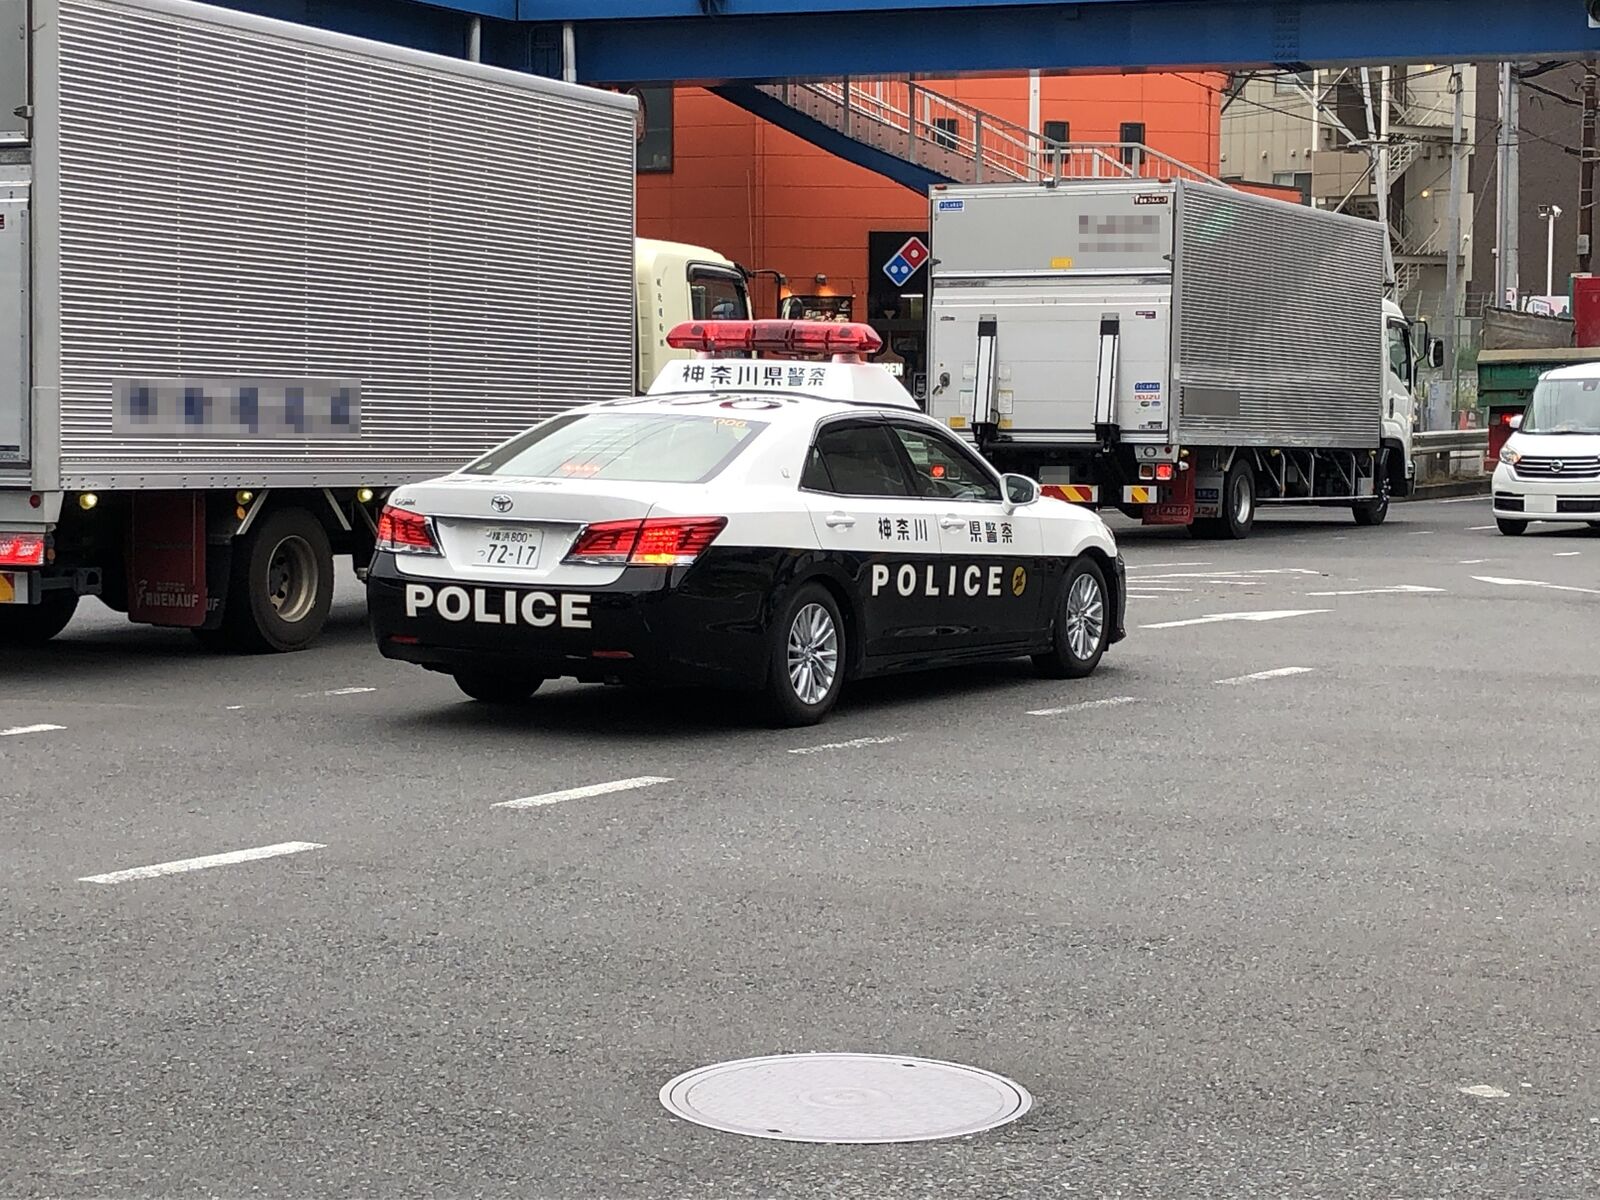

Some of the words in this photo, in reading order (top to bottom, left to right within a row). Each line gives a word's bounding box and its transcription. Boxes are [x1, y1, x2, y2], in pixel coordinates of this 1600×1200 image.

[682, 364, 826, 387] 神奈川県警察
[882, 362, 904, 376] PEN
[878, 516, 929, 542] 神奈川
[969, 520, 1013, 544] 県警察
[487, 543, 537, 565] 72-17
[871, 563, 1003, 597] POLICE
[405, 583, 593, 629] POLICE
